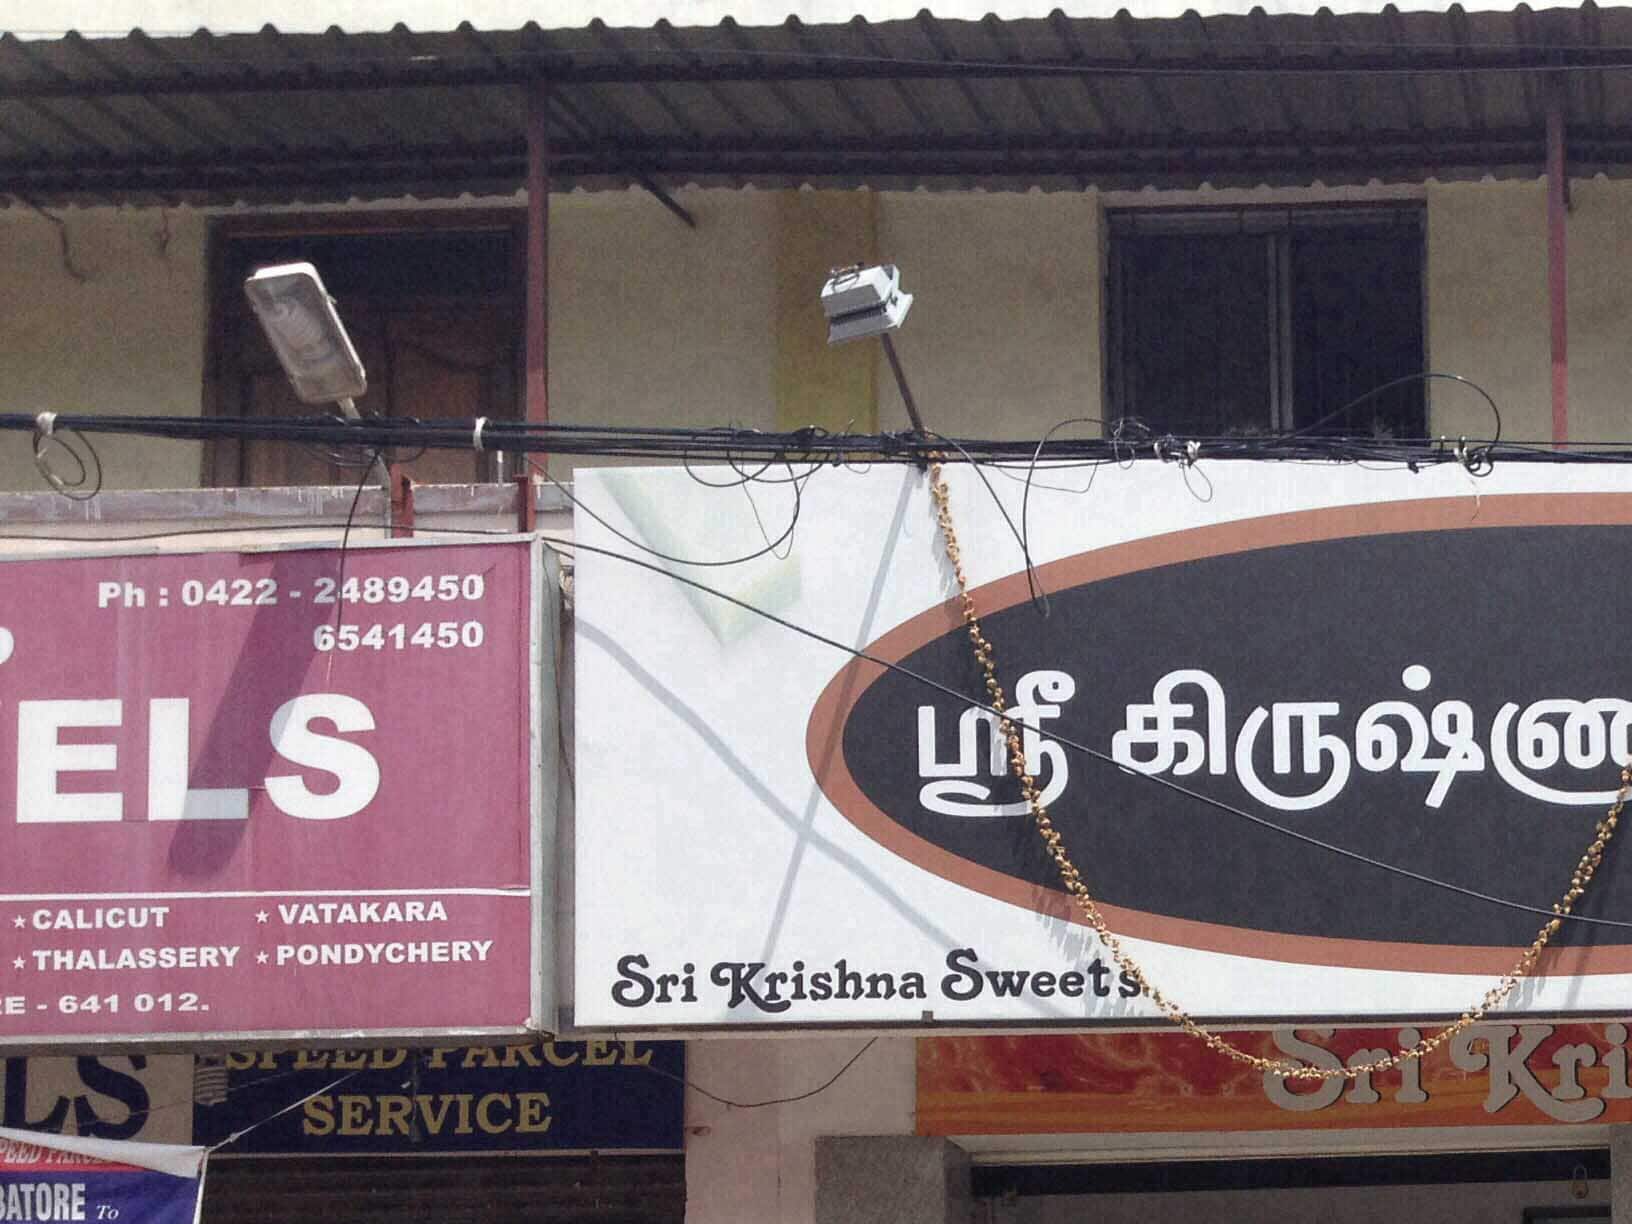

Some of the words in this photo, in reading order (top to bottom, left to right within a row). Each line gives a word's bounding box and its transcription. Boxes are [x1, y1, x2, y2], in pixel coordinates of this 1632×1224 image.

[97, 581, 146, 609] Ph
[181, 579, 279, 607] 0422
[312, 574, 485, 604] 2489450
[312, 621, 485, 652] 6541450
[16, 692, 382, 824] ELS
[32, 906, 170, 931] CALICUT
[277, 900, 449, 926] VATAKARA
[32, 946, 241, 972] THALASSERY
[275, 940, 494, 967] PONDYCHERY
[611, 954, 698, 1009] Sri
[709, 959, 928, 1014] Krishna
[940, 948, 1143, 1003] Sweets
[58, 993, 121, 1014] 641
[1262, 1026, 1431, 1111] Sri
[302, 1091, 553, 1136] SERVICE
[96, 1204, 120, 1221] To
